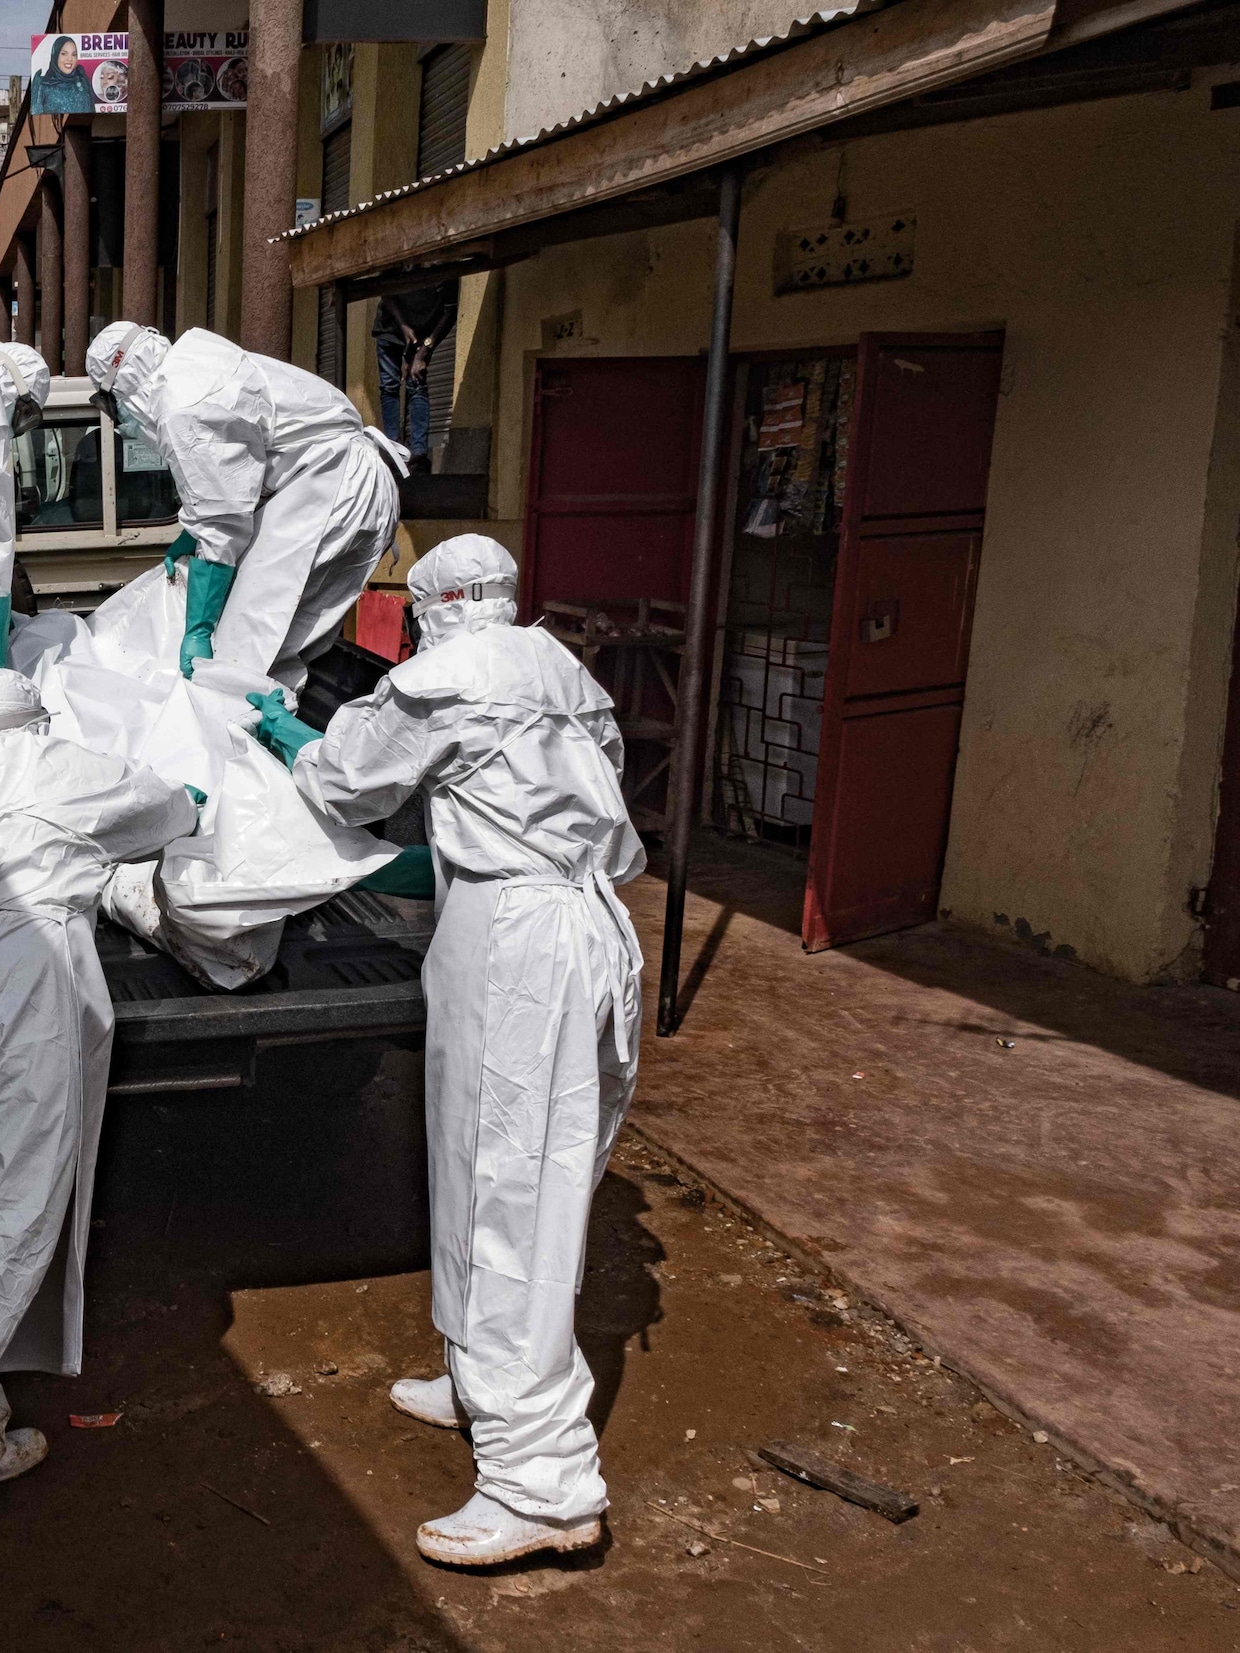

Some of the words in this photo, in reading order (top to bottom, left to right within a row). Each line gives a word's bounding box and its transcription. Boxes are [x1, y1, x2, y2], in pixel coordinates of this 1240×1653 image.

[165, 32, 218, 49] EAUTY
[111, 350, 125, 368] 3M
[440, 588, 465, 603] 3M
